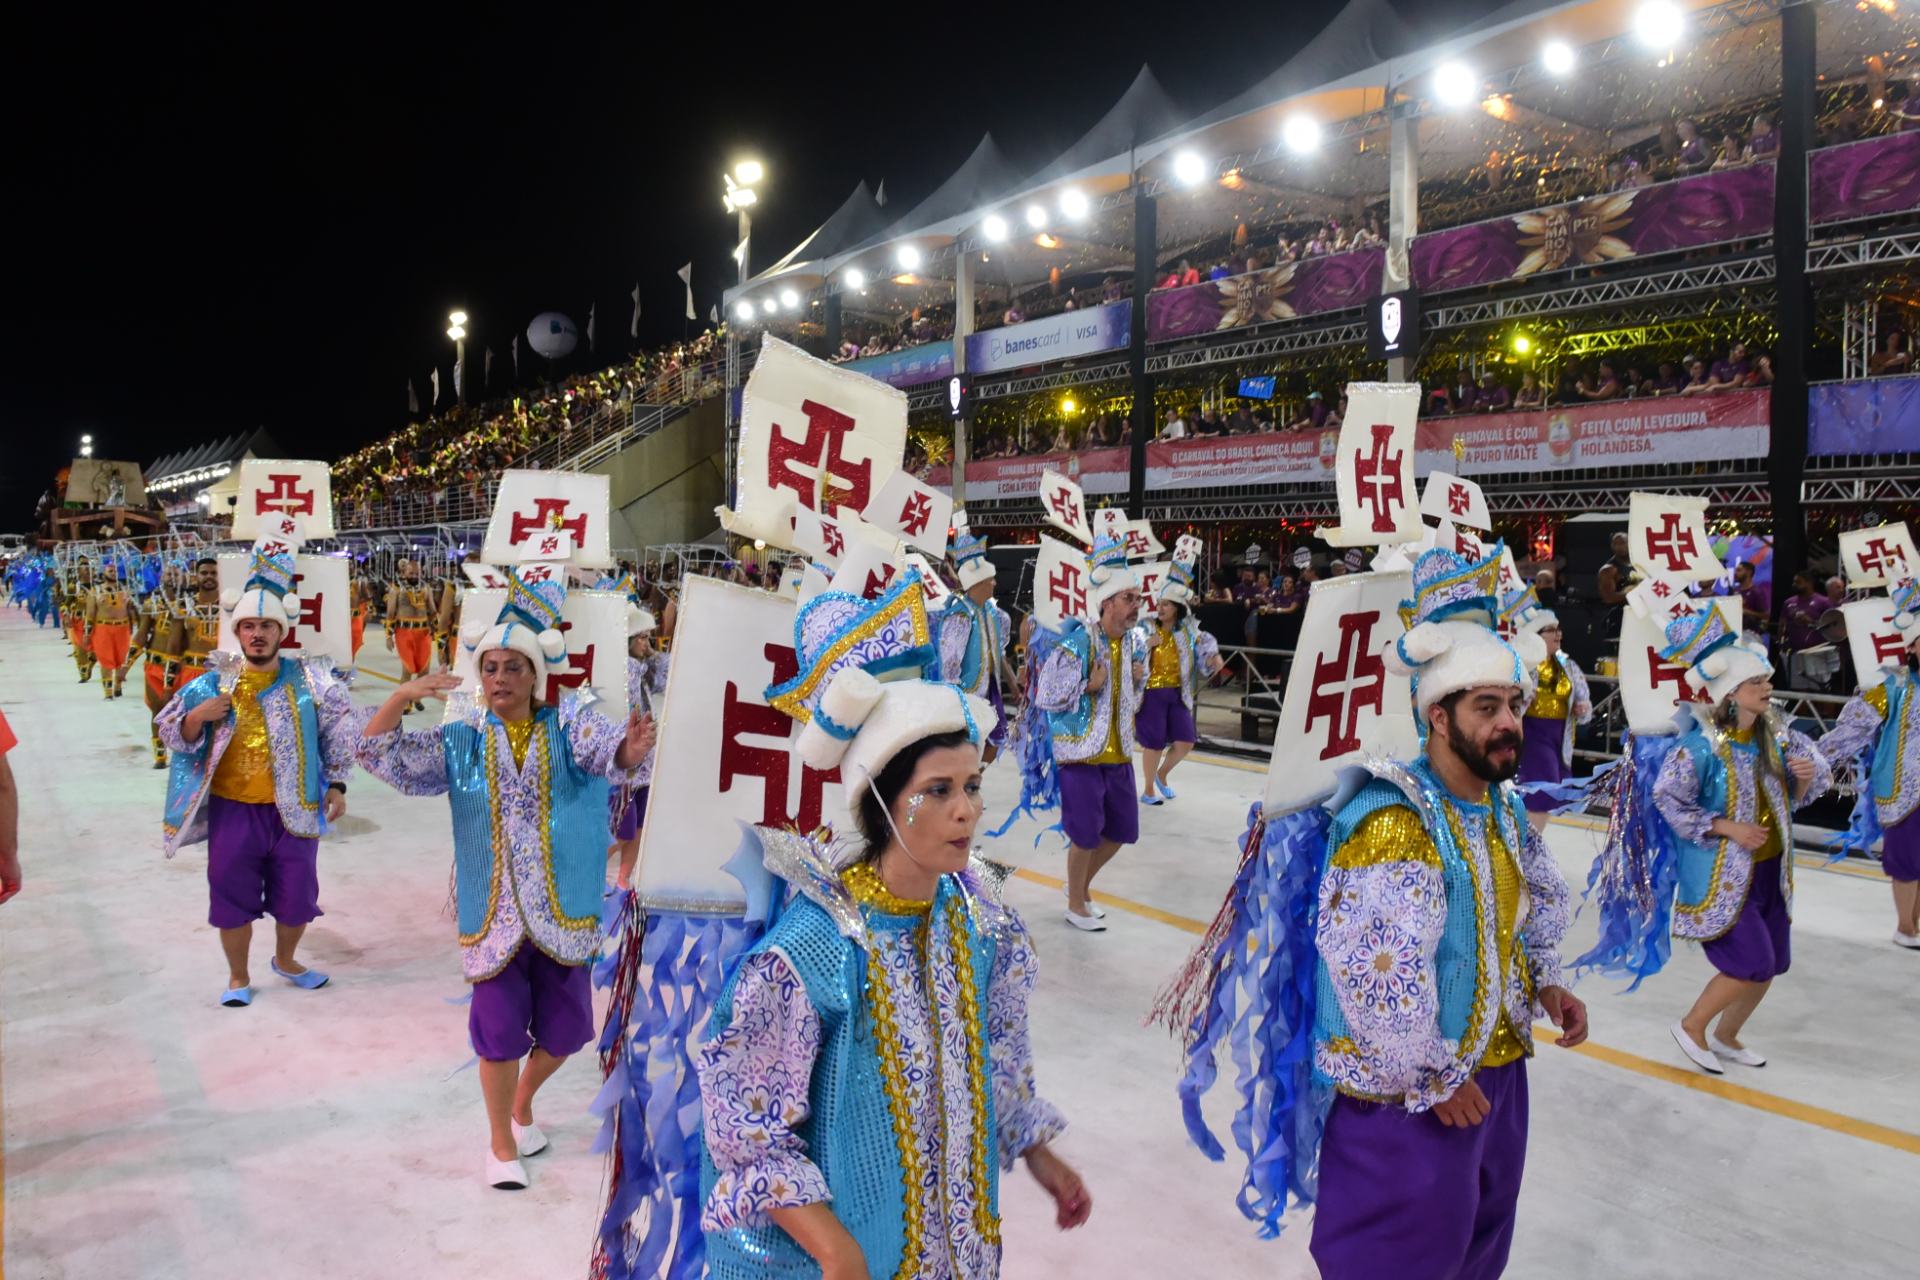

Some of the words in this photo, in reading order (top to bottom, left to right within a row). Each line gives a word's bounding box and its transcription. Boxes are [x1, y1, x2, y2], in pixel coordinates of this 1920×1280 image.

[1573, 215, 1597, 233] P12
[1005, 328, 1061, 355] banescard
[1076, 324, 1098, 340] VISA
[1581, 419, 1612, 436] FEITA
[1615, 416, 1640, 432] COM
[1644, 411, 1707, 430] LEVEDURA
[1514, 426, 1538, 440] COM
[1178, 448, 1214, 463] CARNAVAL
[1227, 446, 1254, 460] BRASIL
[1465, 451, 1472, 464] A
[1474, 449, 1501, 463] PURO
[1504, 446, 1538, 461] MALTE
[1581, 438, 1655, 457] HOLANDESA.
